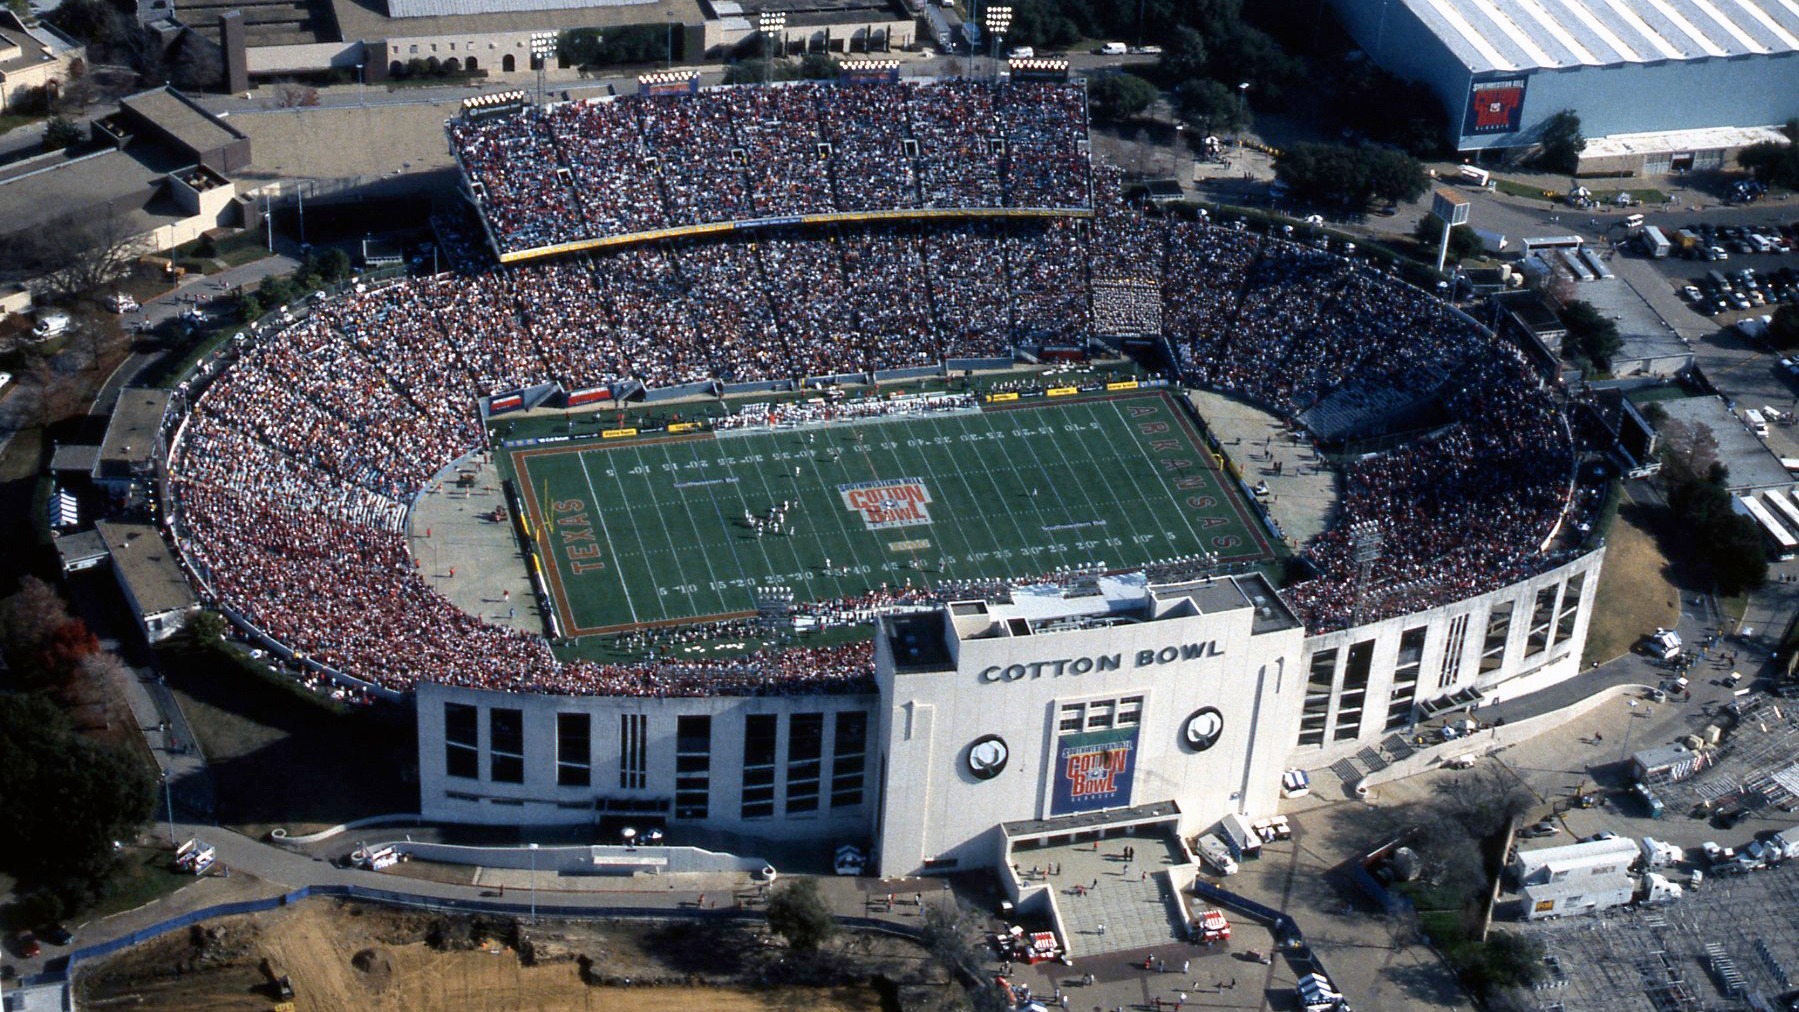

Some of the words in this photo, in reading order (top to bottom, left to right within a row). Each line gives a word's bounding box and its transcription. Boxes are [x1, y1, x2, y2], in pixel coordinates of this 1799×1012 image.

[839, 480, 901, 492] SOUTHWESTERN
[901, 477, 923, 485] BELL
[1127, 406, 1242, 549] ARKANSAS
[848, 484, 926, 510] COTTON
[865, 500, 927, 523] BOWL
[553, 499, 605, 574] TEXAS
[980, 653, 1121, 684] COTTON
[1136, 640, 1224, 667] BOWL
[1066, 748, 1128, 779] COTTON
[1071, 769, 1117, 796] BOWL
